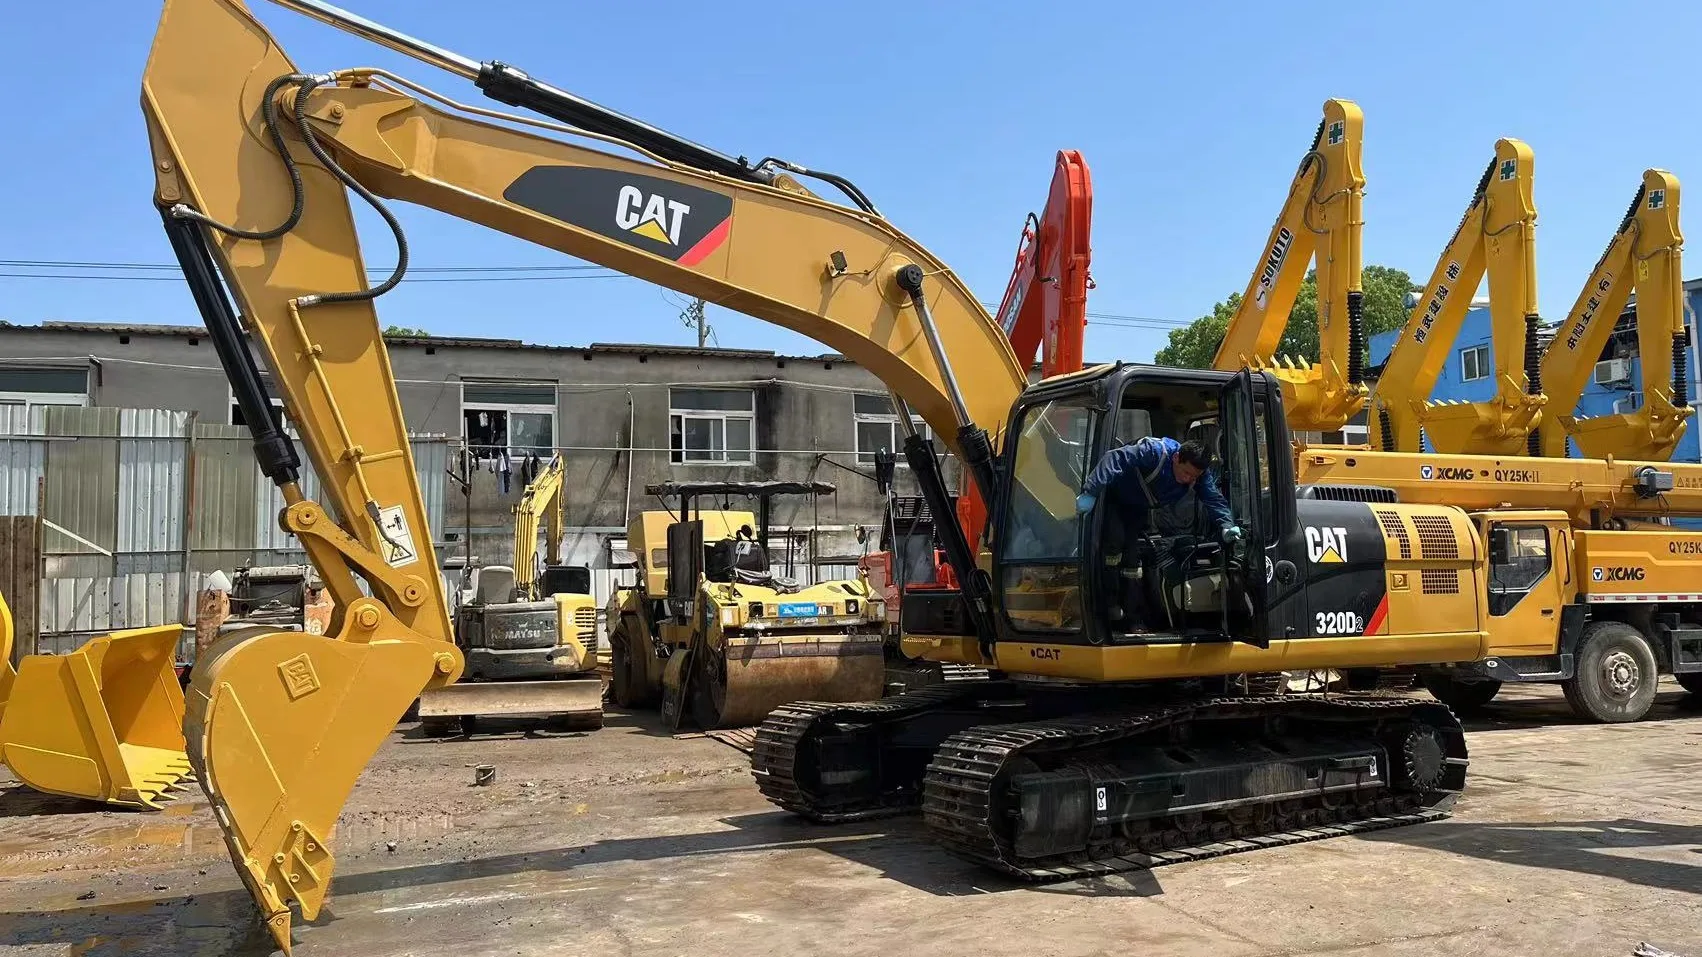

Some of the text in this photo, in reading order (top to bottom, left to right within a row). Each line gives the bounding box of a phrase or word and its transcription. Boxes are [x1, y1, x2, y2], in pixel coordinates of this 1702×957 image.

[615, 185, 690, 246] CAT
[1260, 227, 1291, 287] SOKUTO
[1436, 467, 1474, 480] XCMG
[1304, 526, 1348, 563] CAT
[1605, 567, 1645, 581] XCMG
[1315, 611, 1364, 634] 320D2
[1036, 647, 1061, 660] CAT
